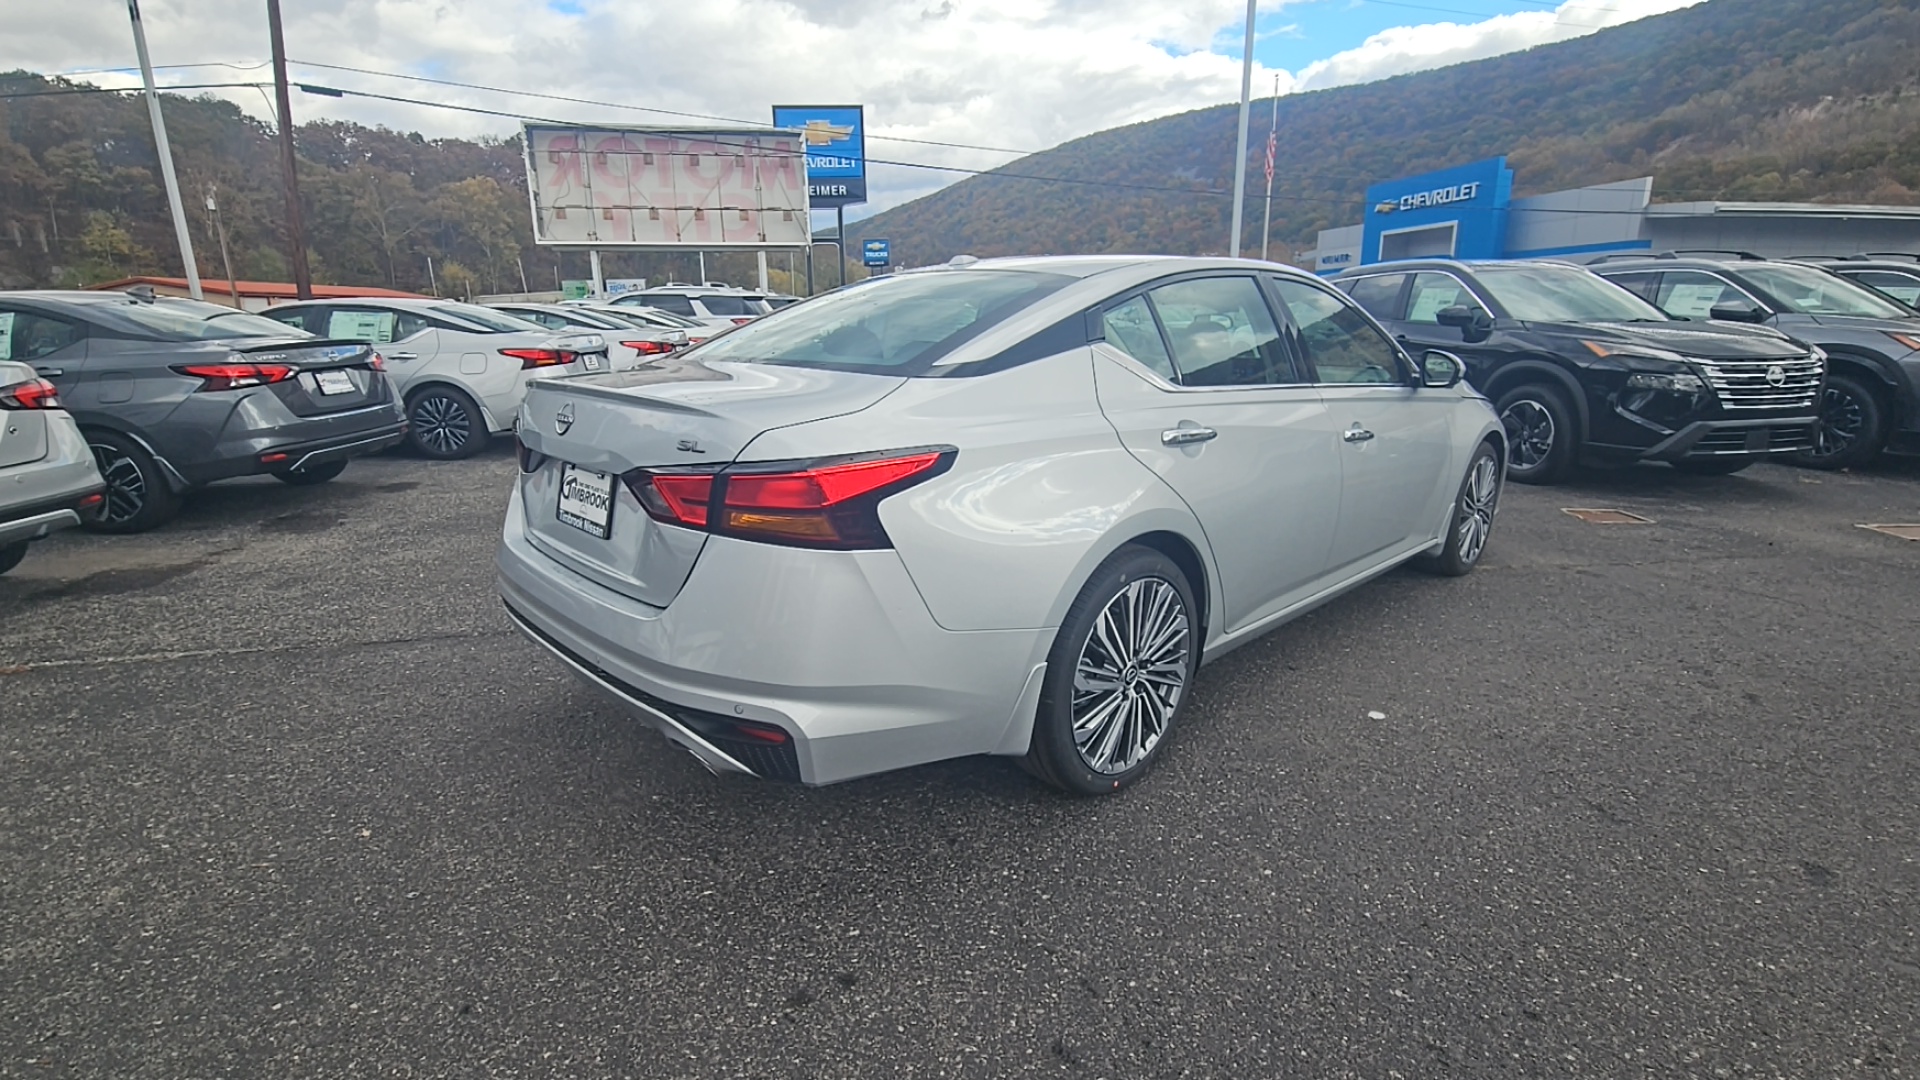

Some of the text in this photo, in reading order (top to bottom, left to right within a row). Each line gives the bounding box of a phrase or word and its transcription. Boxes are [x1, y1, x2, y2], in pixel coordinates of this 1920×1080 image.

[808, 184, 848, 196] EIMER
[1400, 181, 1480, 211] CHEVROLET
[676, 440, 706, 454] SL
[562, 475, 610, 512] TIMBROOK
[583, 519, 605, 538] Nissan
